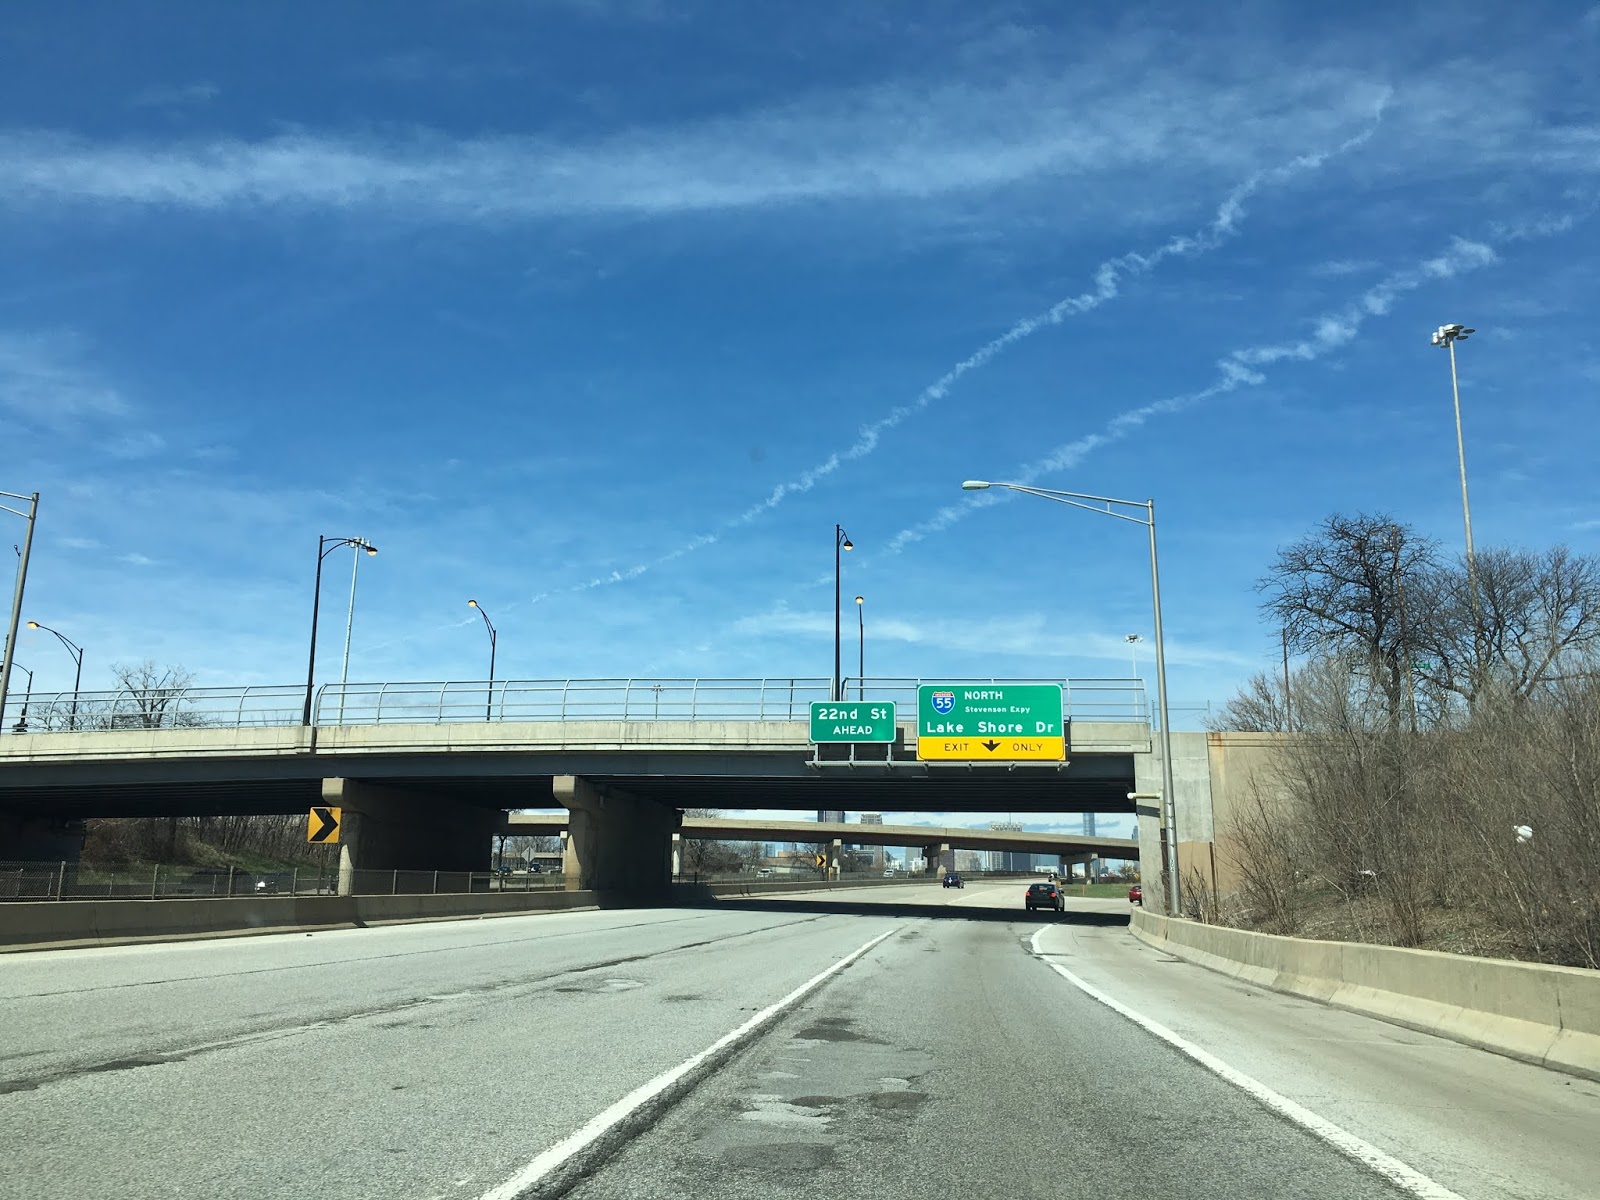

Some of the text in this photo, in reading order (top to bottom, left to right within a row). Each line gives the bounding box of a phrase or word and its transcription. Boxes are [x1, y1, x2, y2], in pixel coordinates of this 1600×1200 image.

[964, 691, 1003, 700] NORTH
[936, 698, 952, 708] 55
[819, 708, 887, 719] 22nd St
[1010, 706, 1031, 714] Expy
[833, 726, 872, 735] AHEAD
[927, 721, 1054, 733] Lake Shore Dr
[945, 743, 1043, 752] EXIT ONLY
